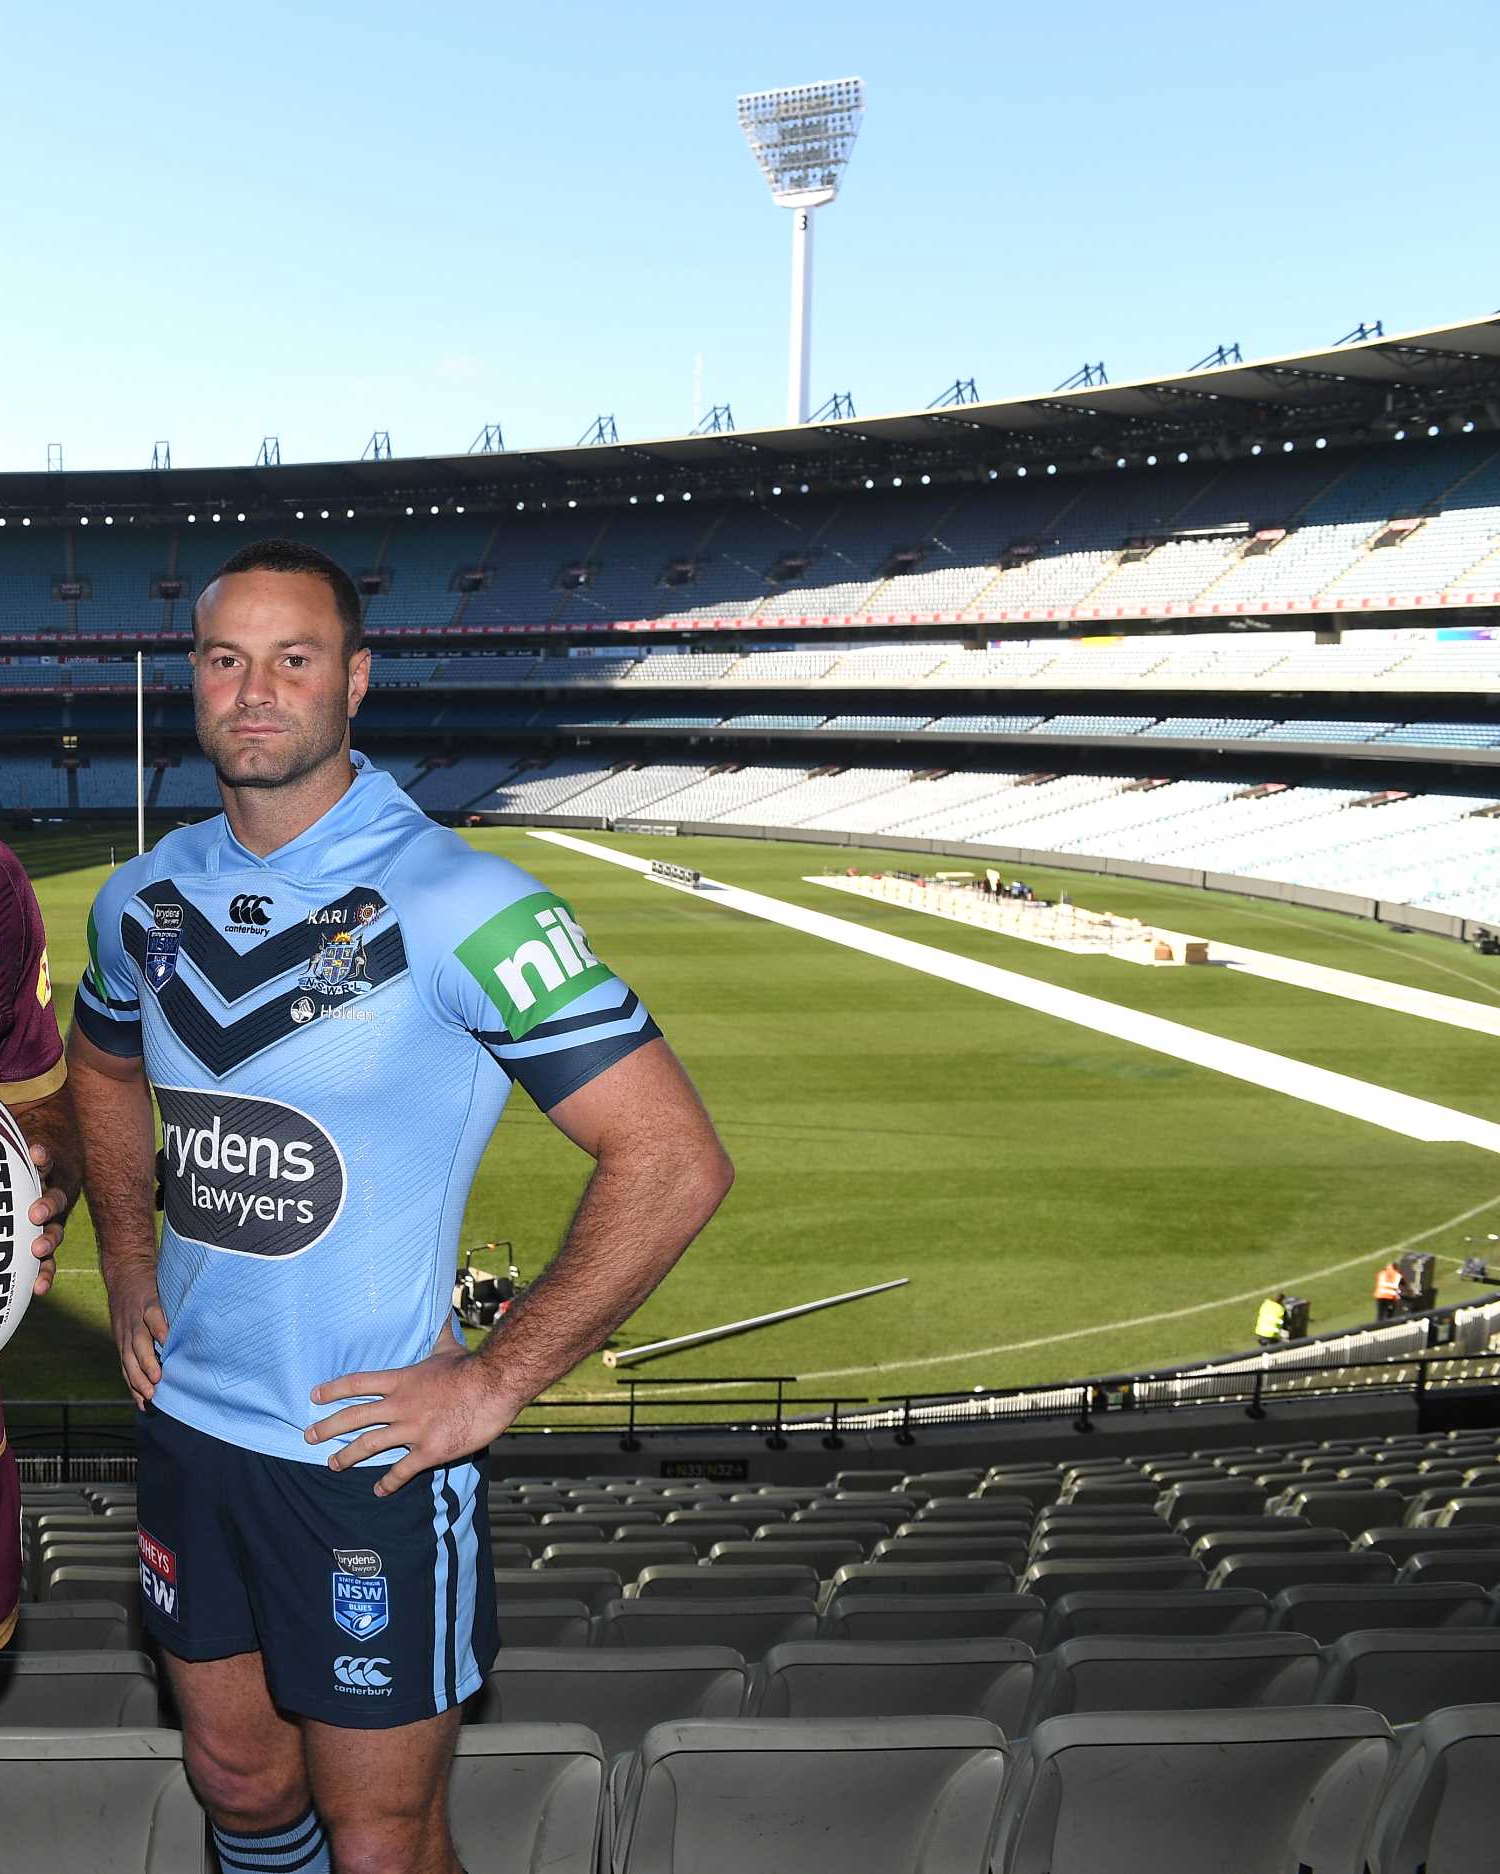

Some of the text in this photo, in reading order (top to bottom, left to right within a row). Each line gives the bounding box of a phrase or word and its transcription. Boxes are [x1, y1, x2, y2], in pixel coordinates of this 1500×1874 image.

[799, 214, 808, 231] 3
[307, 908, 348, 925] KARI
[224, 924, 270, 938] canterbury
[320, 1003, 374, 1021] Holden
[162, 1115, 315, 1182] rydens
[191, 1172, 315, 1227] lawyers
[138, 1534, 170, 1574] OHEYS
[337, 1553, 376, 1567] brydens
[140, 1560, 175, 1615] EW
[337, 1583, 383, 1601] NSW
[348, 1603, 373, 1612] BLUES
[333, 1684, 393, 1697] canterbury
